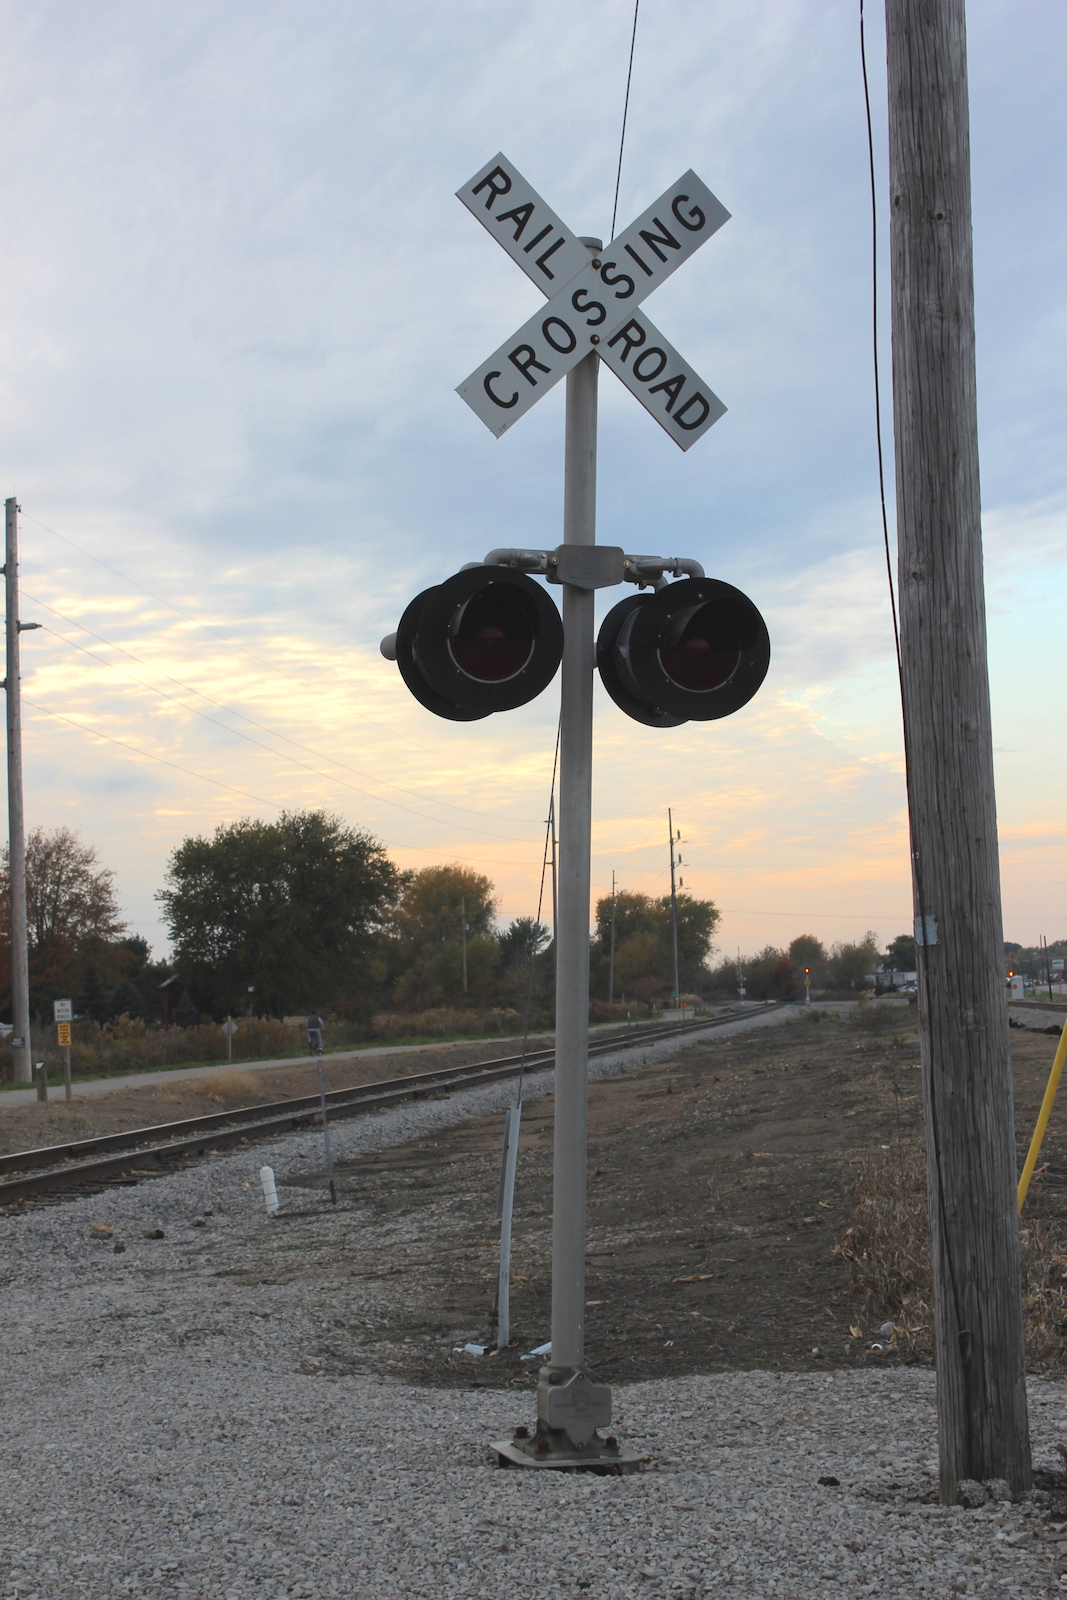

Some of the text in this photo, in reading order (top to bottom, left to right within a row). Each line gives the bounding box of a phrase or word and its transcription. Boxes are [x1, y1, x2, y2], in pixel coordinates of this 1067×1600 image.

[472, 165, 710, 430] RAIL ROAD
[483, 194, 706, 409] CROSSING
